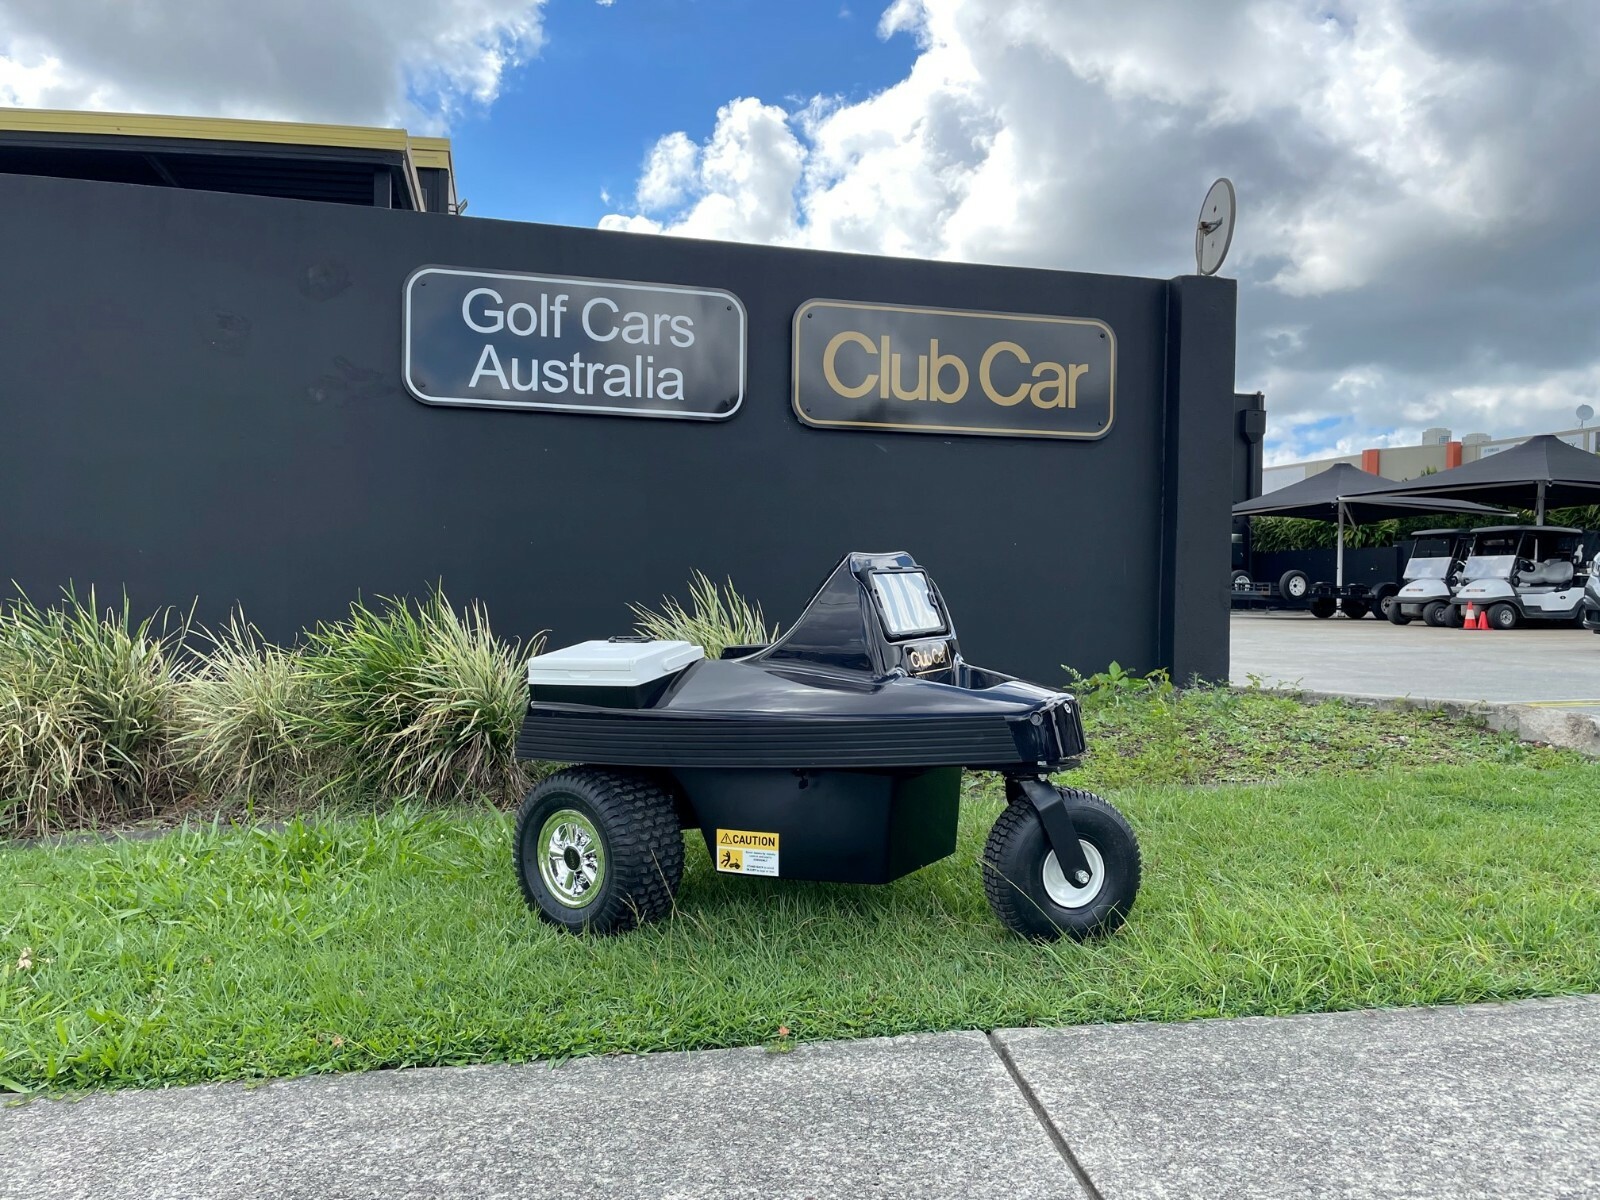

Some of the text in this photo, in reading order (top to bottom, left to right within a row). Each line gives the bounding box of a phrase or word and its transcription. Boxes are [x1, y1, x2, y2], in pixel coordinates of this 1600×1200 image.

[462, 288, 695, 348] Golf Cars
[468, 344, 685, 400] Australia
[823, 331, 1089, 408] Club Car
[911, 650, 932, 668] Club
[732, 834, 775, 847] CAUTION
